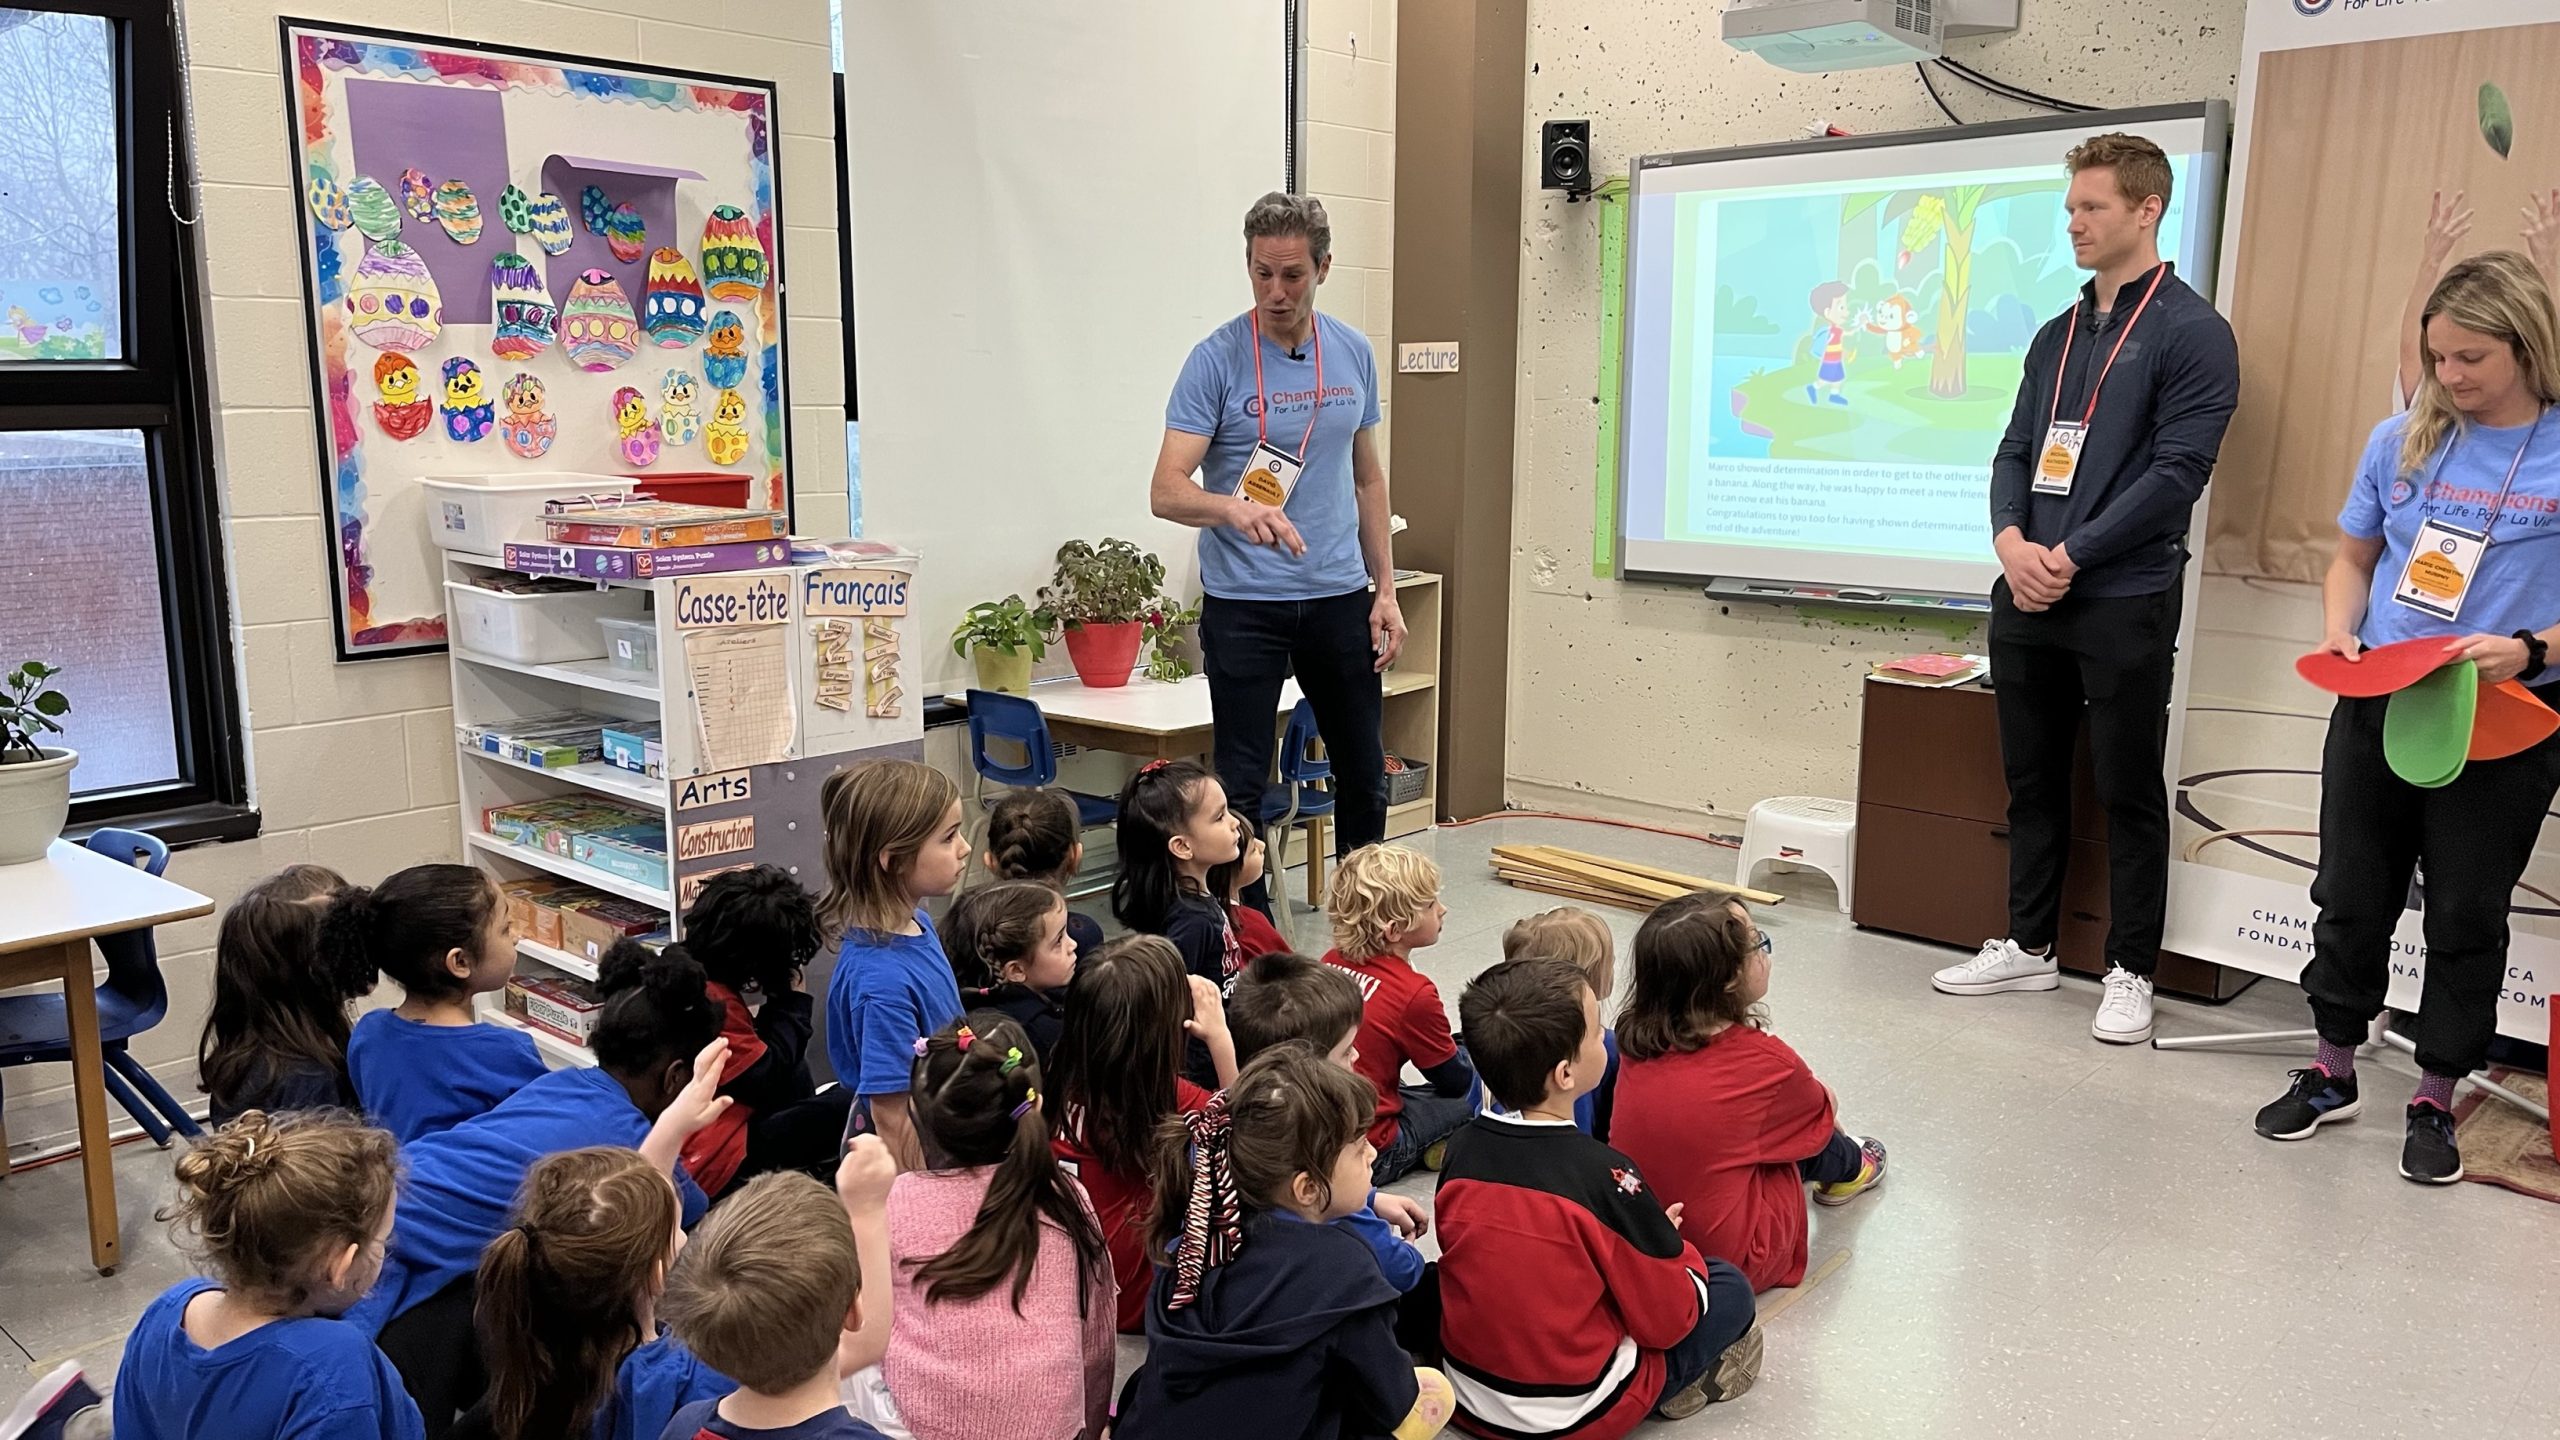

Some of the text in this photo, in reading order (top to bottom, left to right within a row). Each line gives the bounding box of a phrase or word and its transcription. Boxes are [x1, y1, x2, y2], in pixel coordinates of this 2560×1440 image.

[1400, 345, 1458, 370] Lecture
[1272, 386, 1355, 405] Champions
[1274, 406, 1288, 414] For
[1708, 462, 1735, 472] Marco
[1737, 463, 1771, 474] showed
[1773, 464, 1840, 477] determination
[1842, 467, 1851, 476] in
[1852, 468, 1879, 478] order
[1882, 470, 1892, 478] to
[1894, 470, 1910, 481] get
[1912, 471, 1923, 480] to
[1925, 471, 1942, 480] the
[1944, 472, 1972, 482] other
[1707, 493, 1720, 502] He
[1720, 494, 1737, 502] can
[1738, 496, 1757, 504] now
[1759, 496, 1773, 504] eat
[1776, 496, 1789, 506] his
[1752, 480, 1778, 492] Along
[1780, 480, 1795, 490] the
[1797, 482, 1818, 493] way,
[1820, 482, 1832, 492] he
[1834, 485, 1852, 494] was
[1854, 484, 1886, 496] happy
[1887, 486, 1898, 495] to
[1900, 487, 1926, 497] meet
[1928, 489, 1934, 497] a
[1936, 489, 1958, 498] new
[2424, 479, 2560, 513] Champions
[1706, 508, 1777, 521] Congratulations
[1778, 512, 1789, 521] to
[1790, 514, 1807, 524] you
[1809, 514, 1826, 524] too
[1827, 514, 1840, 524] for
[1842, 515, 1875, 528] having
[1877, 518, 1910, 528] shown
[1911, 519, 1984, 532] determination
[2444, 504, 2469, 517] Life
[2510, 514, 2528, 525] La
[1706, 522, 1800, 537] end of the adventure!
[672, 554, 695, 562] System
[678, 579, 788, 624] Casse-tête
[805, 571, 907, 613] Français
[680, 776, 748, 807] Arts
[680, 820, 753, 858] Construction
[2252, 910, 2307, 931] CHAM
[2238, 927, 2546, 1008] FONDAT NA COM
[529, 1000, 547, 1016] Floor
[546, 1005, 568, 1025] Puzzle
